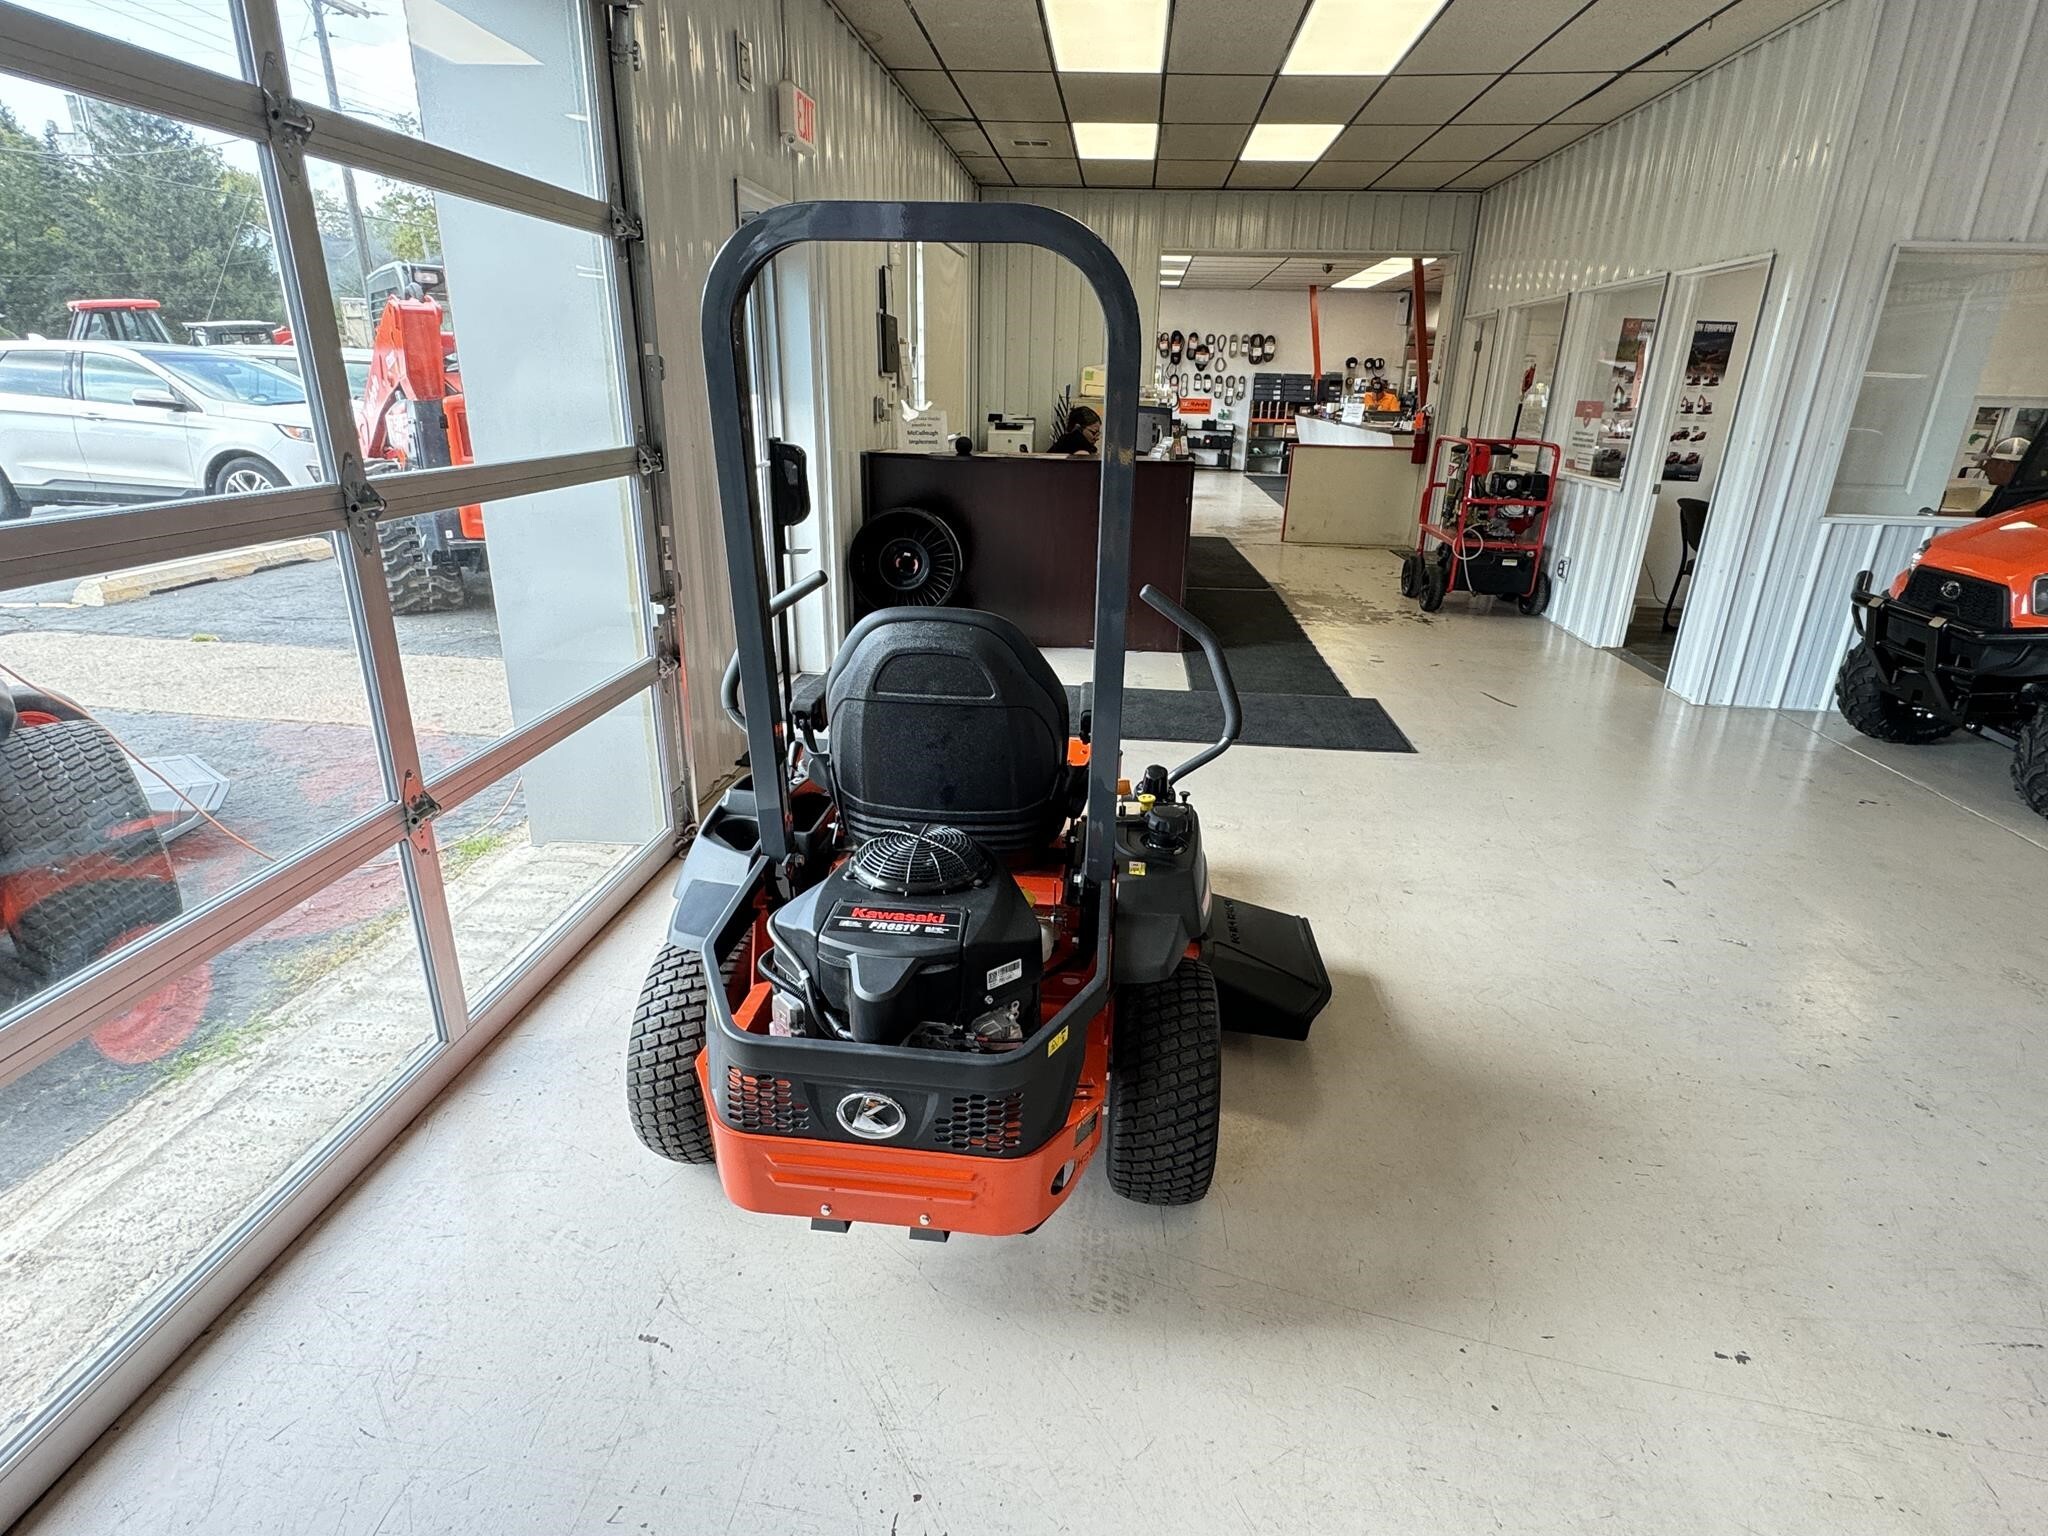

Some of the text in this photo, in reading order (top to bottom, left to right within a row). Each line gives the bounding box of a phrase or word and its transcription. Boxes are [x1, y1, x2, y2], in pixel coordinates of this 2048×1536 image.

[796, 91, 814, 144] EXIT
[851, 907, 946, 924] Kawasaki
[868, 921, 920, 932] FR651V
